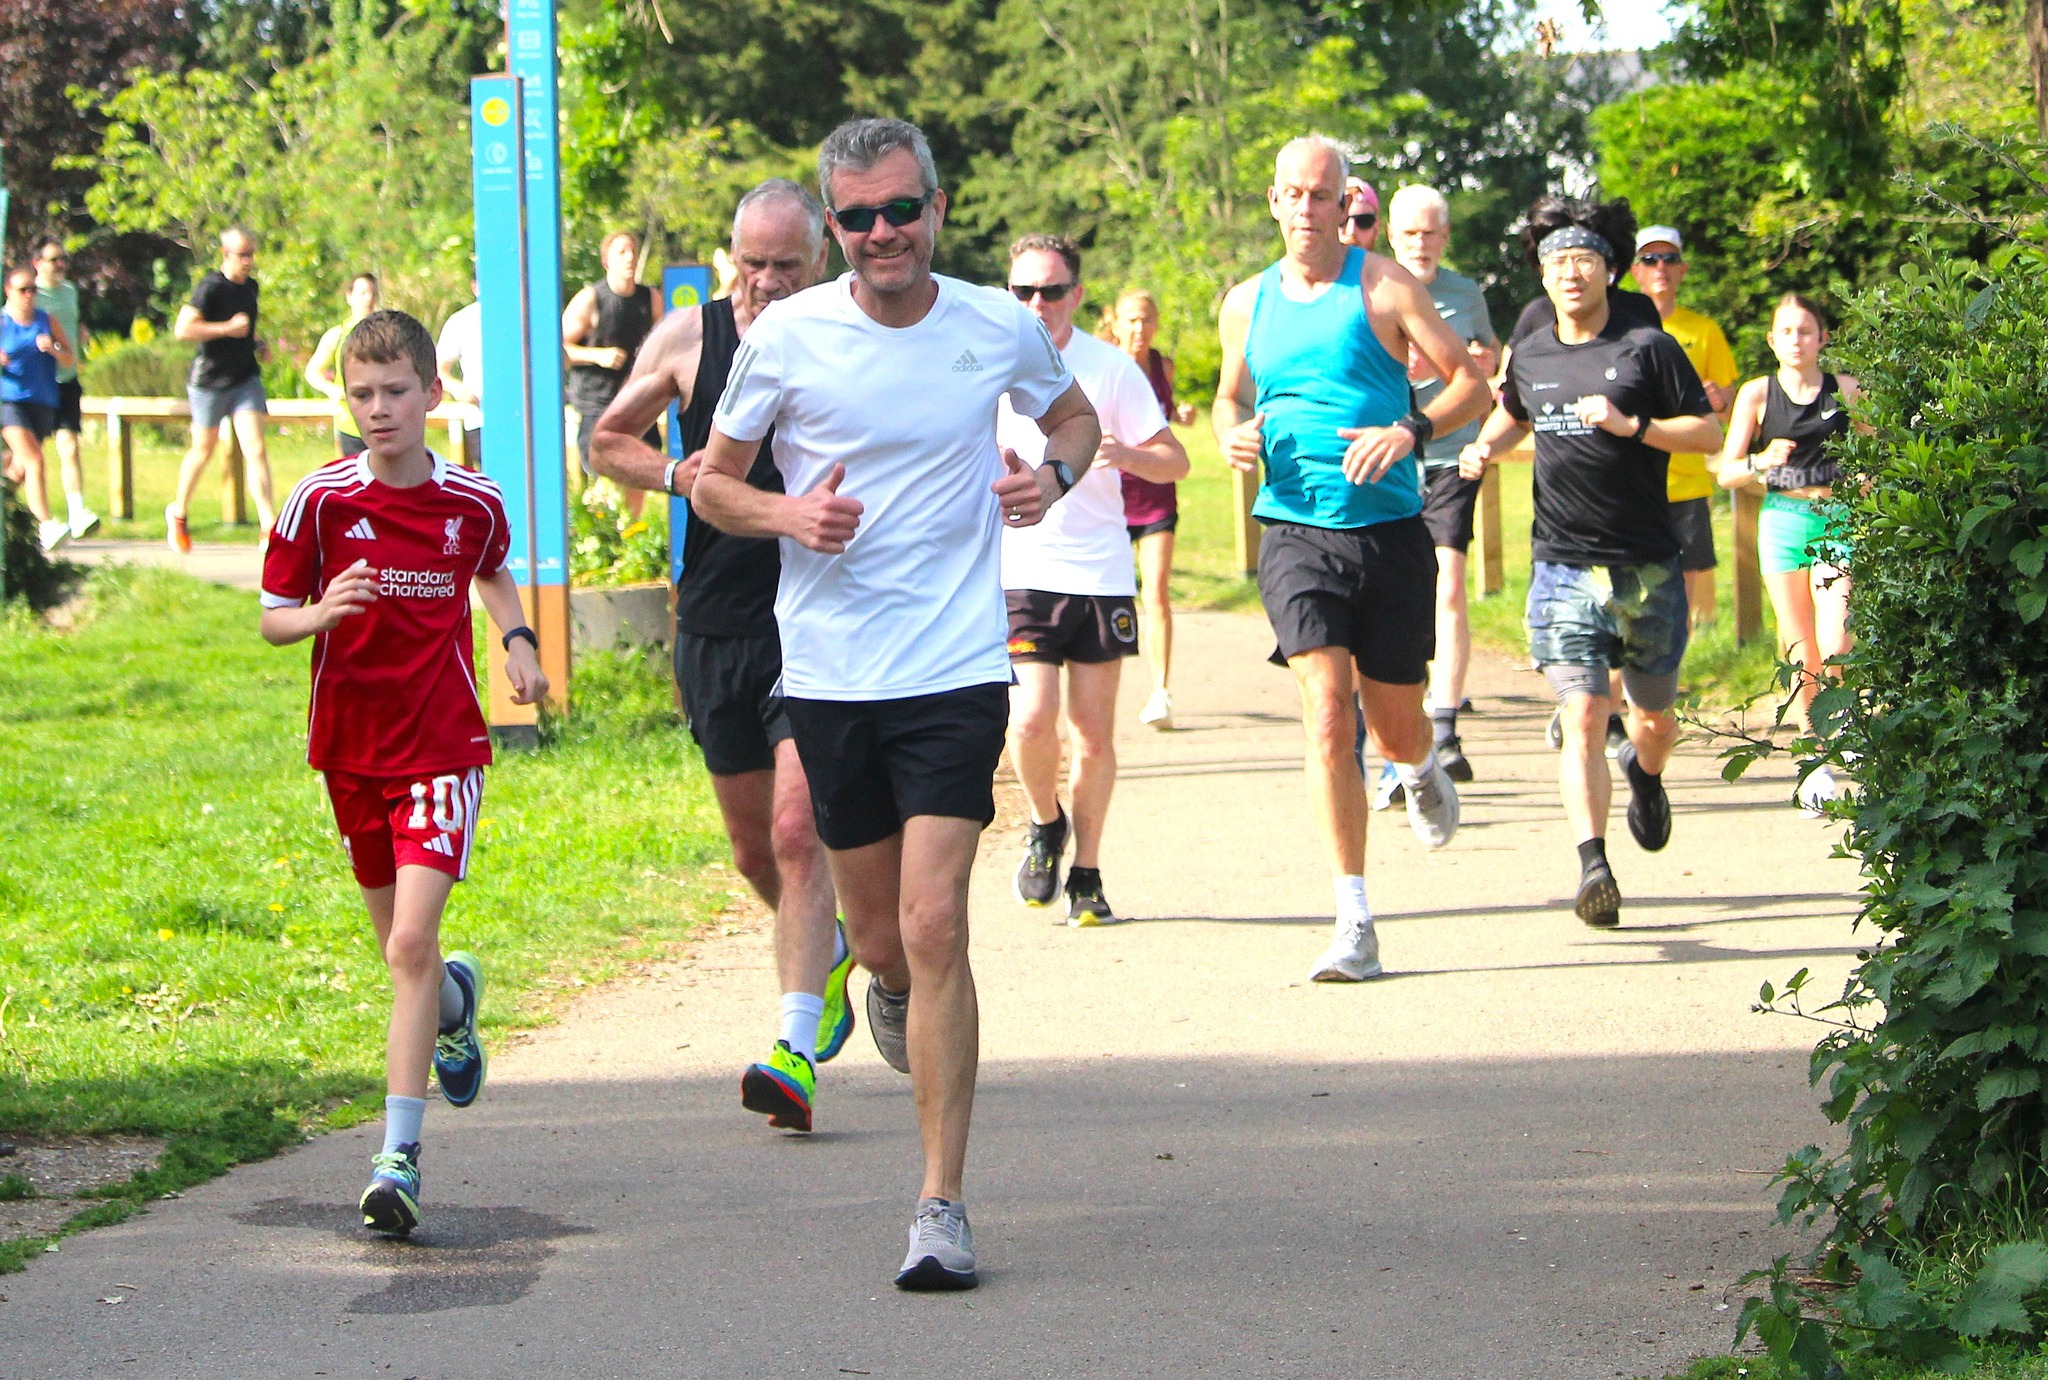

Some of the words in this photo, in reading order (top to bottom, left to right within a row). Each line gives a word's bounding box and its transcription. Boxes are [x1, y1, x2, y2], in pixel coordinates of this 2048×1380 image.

[951, 363, 984, 373] adidas
[443, 544, 461, 555] LFC
[380, 567, 454, 585] standard
[380, 582, 455, 598] chartered
[407, 775, 464, 834] 10
